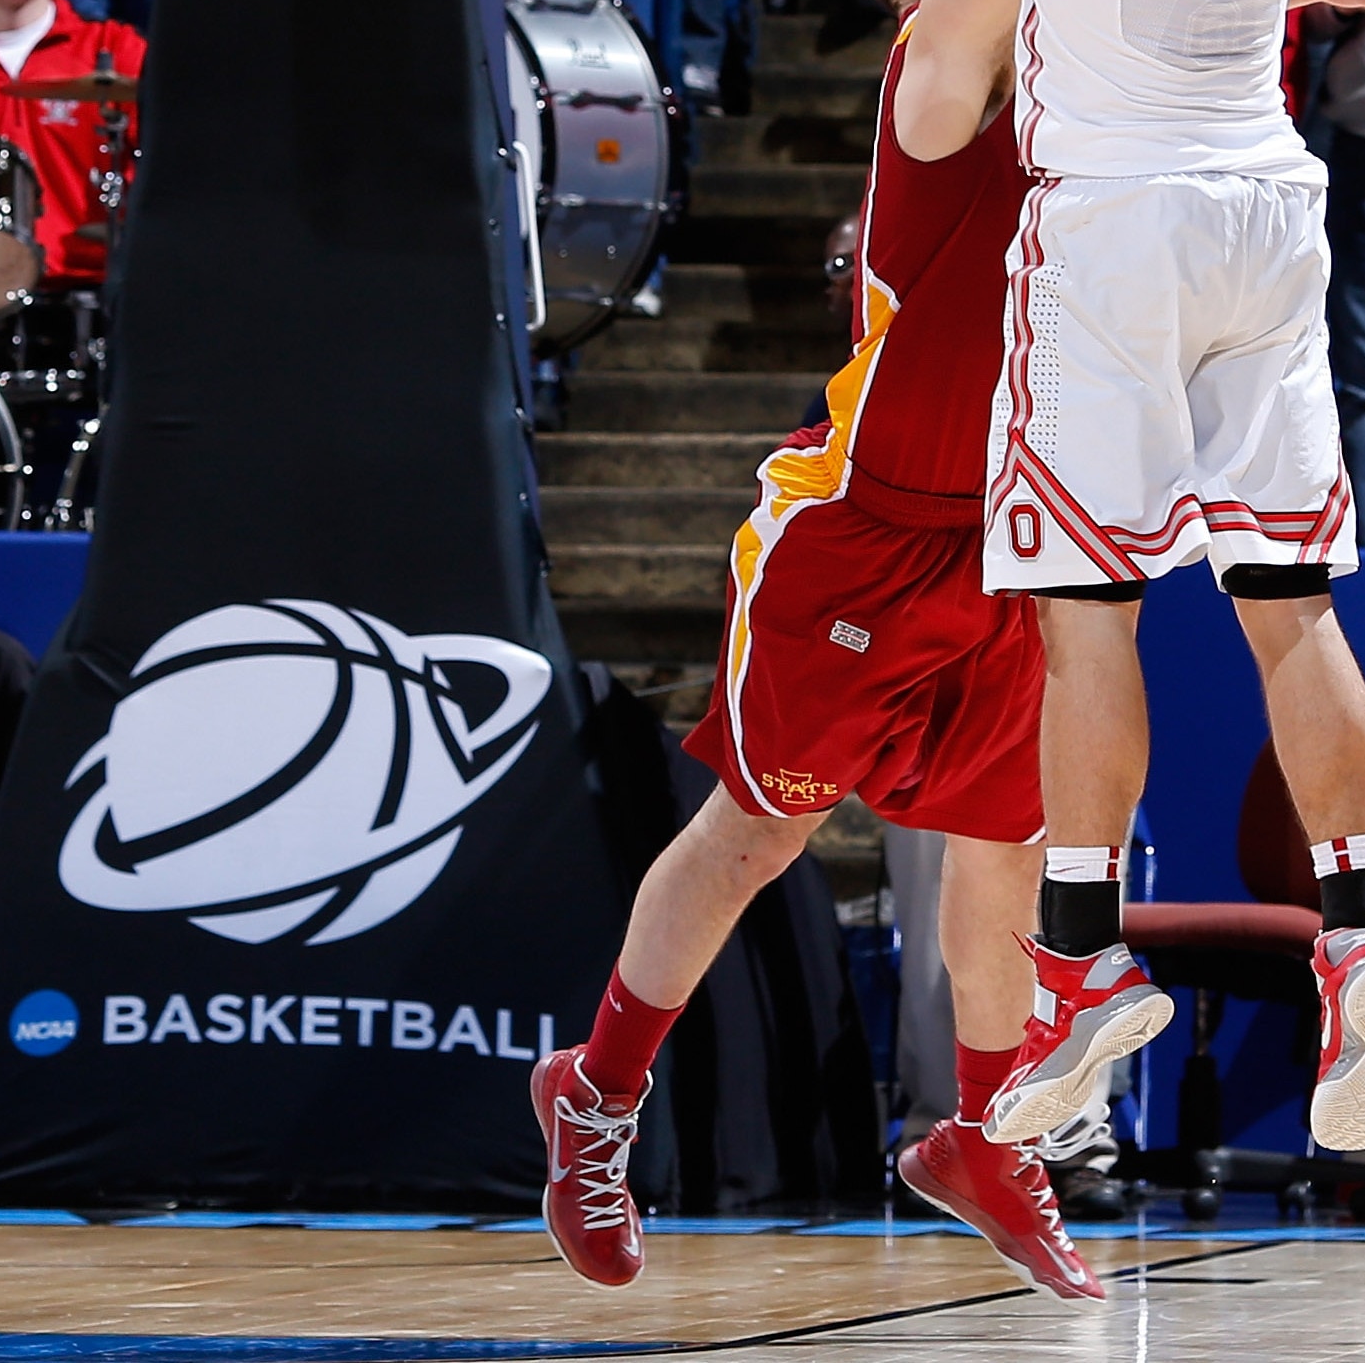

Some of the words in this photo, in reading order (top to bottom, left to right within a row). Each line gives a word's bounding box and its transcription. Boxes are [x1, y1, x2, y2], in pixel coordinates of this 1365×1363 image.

[762, 774, 839, 797] STATE
[15, 1021, 76, 1042] NCAA
[103, 994, 555, 1062] BASKETBALL
